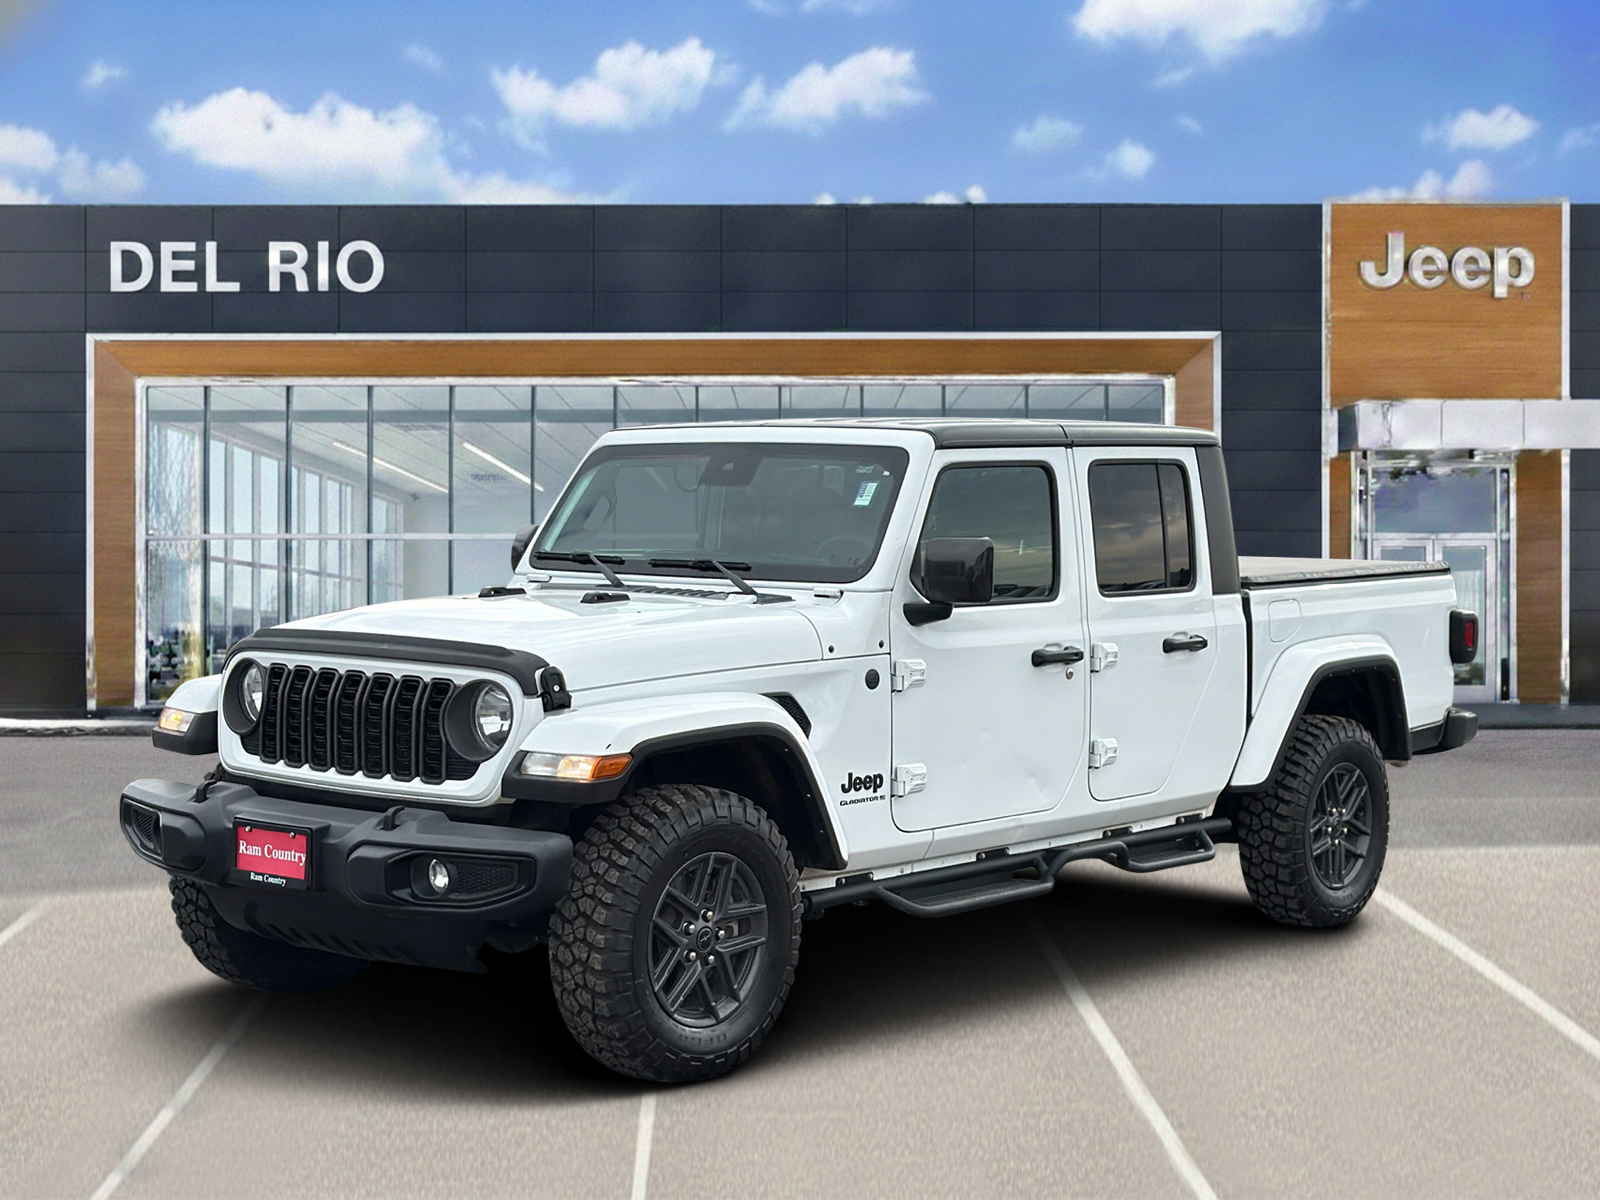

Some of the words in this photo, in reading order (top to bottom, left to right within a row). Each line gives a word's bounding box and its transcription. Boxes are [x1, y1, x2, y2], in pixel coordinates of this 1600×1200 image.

[109, 241, 241, 293] DEL
[268, 239, 386, 293] RIO
[1359, 231, 1536, 299] Jeep
[841, 772, 883, 793] Jeep
[839, 796, 878, 806] GLADIATOR
[239, 840, 262, 856] Ram
[264, 844, 306, 866] Country
[250, 872, 263, 881] Ram
[264, 875, 286, 886] Country
